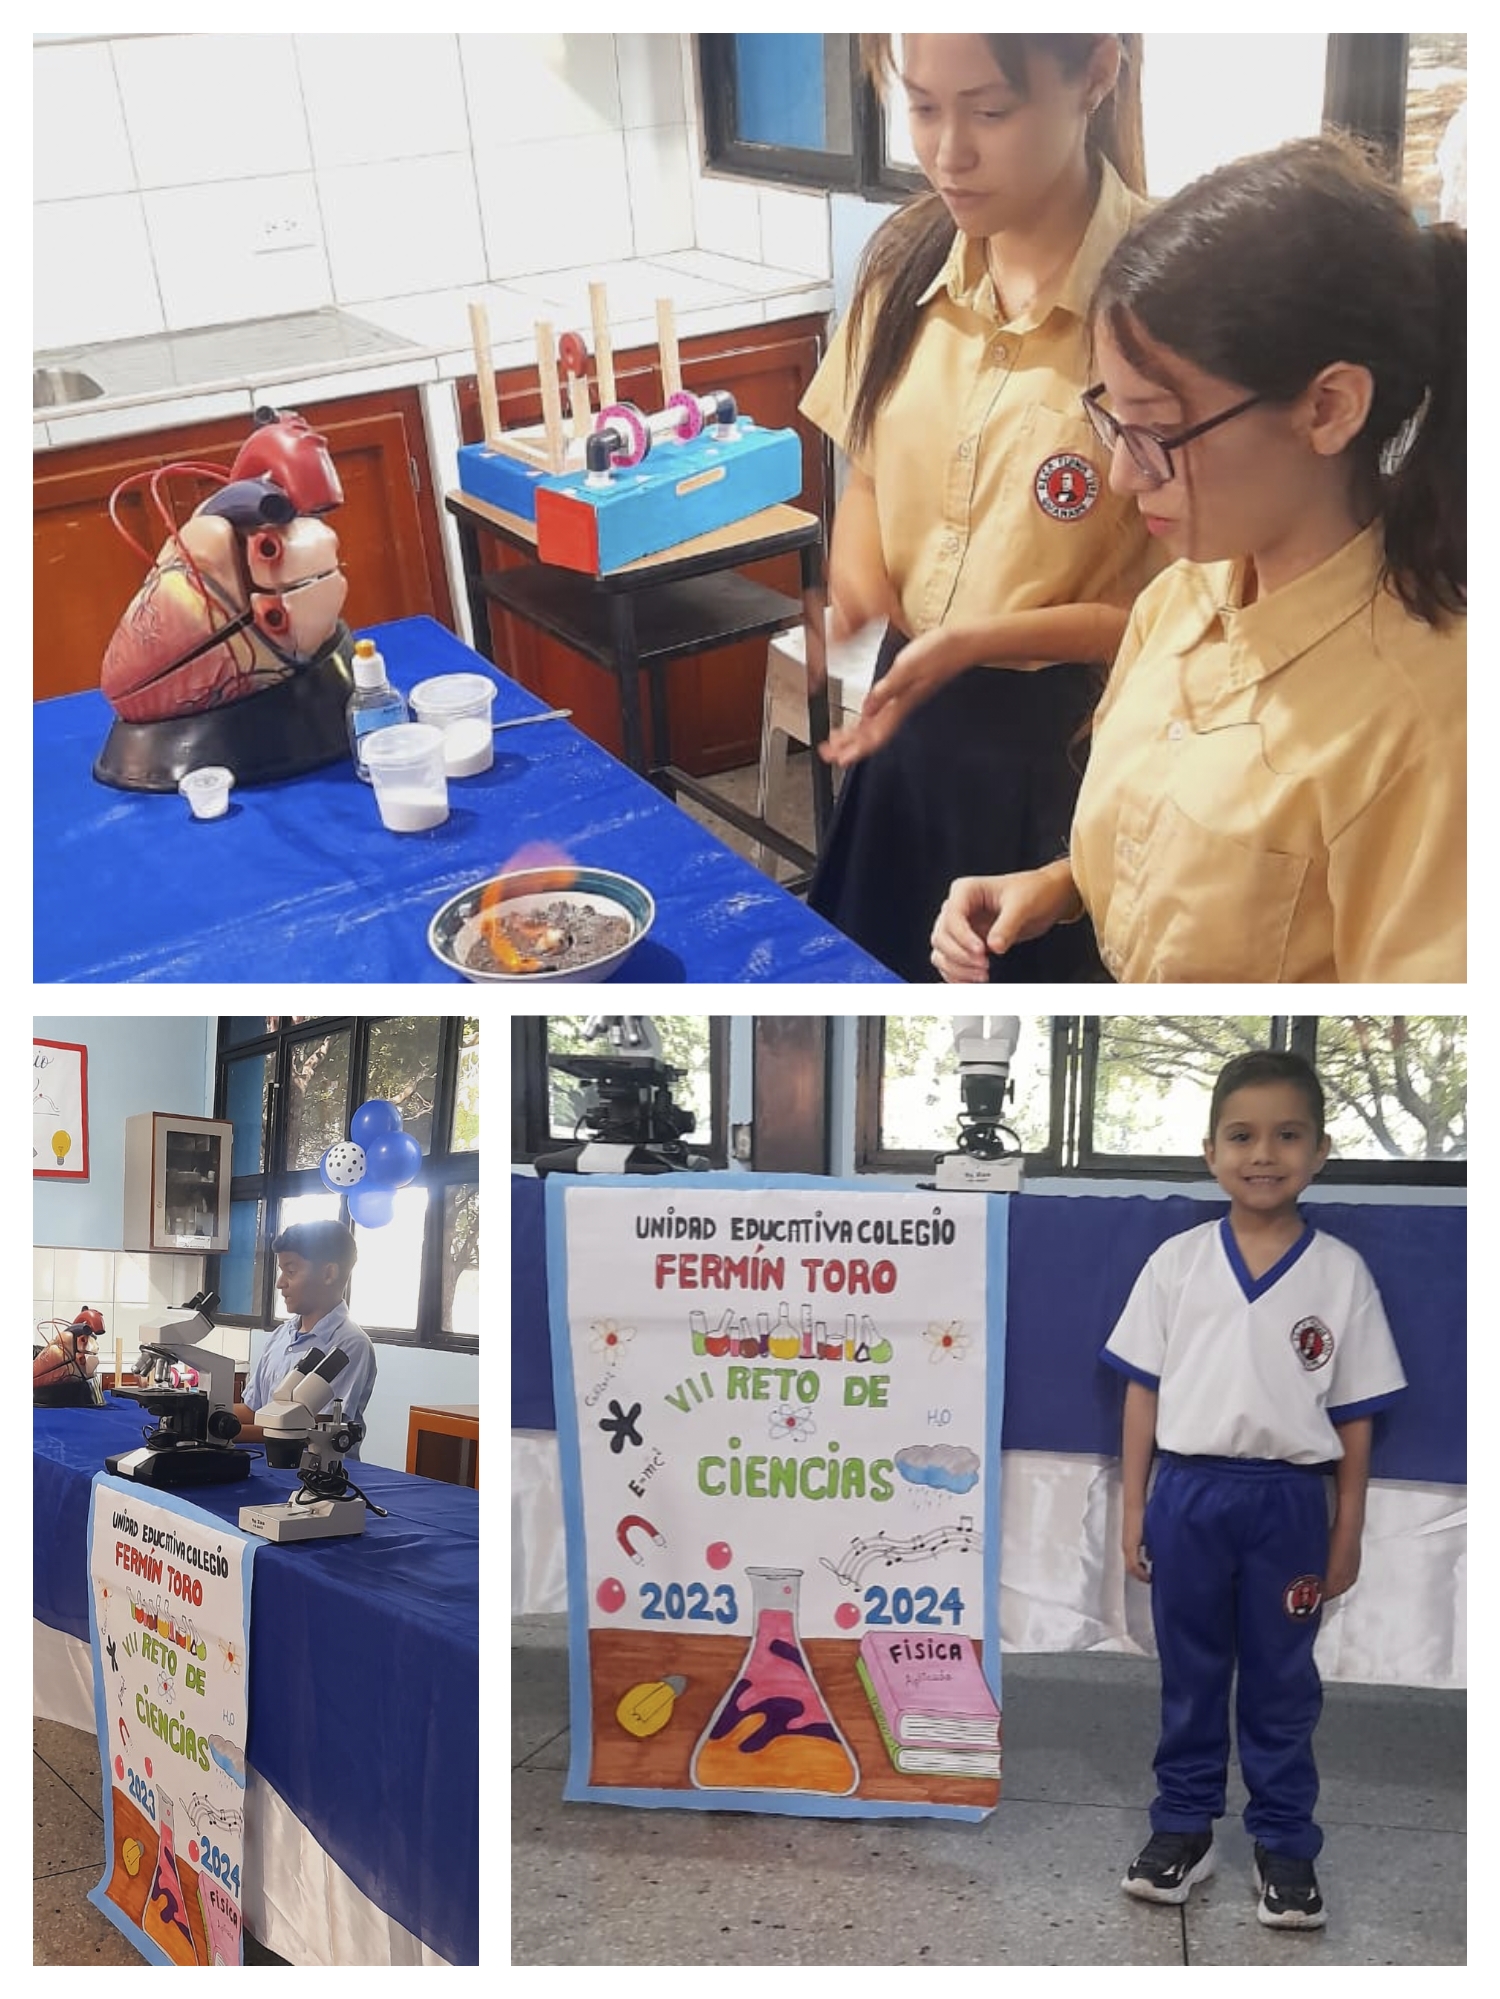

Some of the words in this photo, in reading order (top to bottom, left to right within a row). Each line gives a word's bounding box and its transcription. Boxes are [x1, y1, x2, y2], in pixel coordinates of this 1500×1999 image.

[636, 1206, 717, 1240] UNIDAD
[731, 1209, 853, 1245] EDUCATIVA
[857, 1205, 956, 1246] COLEGIO
[654, 1244, 785, 1290] FERMÍN
[802, 1258, 898, 1294] TORO
[664, 1371, 715, 1414] VII
[727, 1366, 821, 1404] RETO
[844, 1375, 891, 1408] DE
[697, 1436, 895, 1500] CIENCIAS
[112, 1508, 139, 1538] UNIDAD
[142, 1530, 186, 1561] EDUCATIVA
[186, 1545, 229, 1579] COLEGIO
[115, 1541, 163, 1585] FERMÍN
[167, 1565, 203, 1607] TORO
[639, 1582, 739, 1624] 2023
[864, 1584, 966, 1625] 2024
[121, 1631, 138, 1658] VII
[142, 1632, 177, 1677] RETO
[185, 1663, 207, 1697] DE
[889, 1637, 962, 1664] FISICA
[136, 1685, 211, 1772] CIENCIAS
[127, 1767, 156, 1821] 2023
[200, 1835, 241, 1899] 2024
